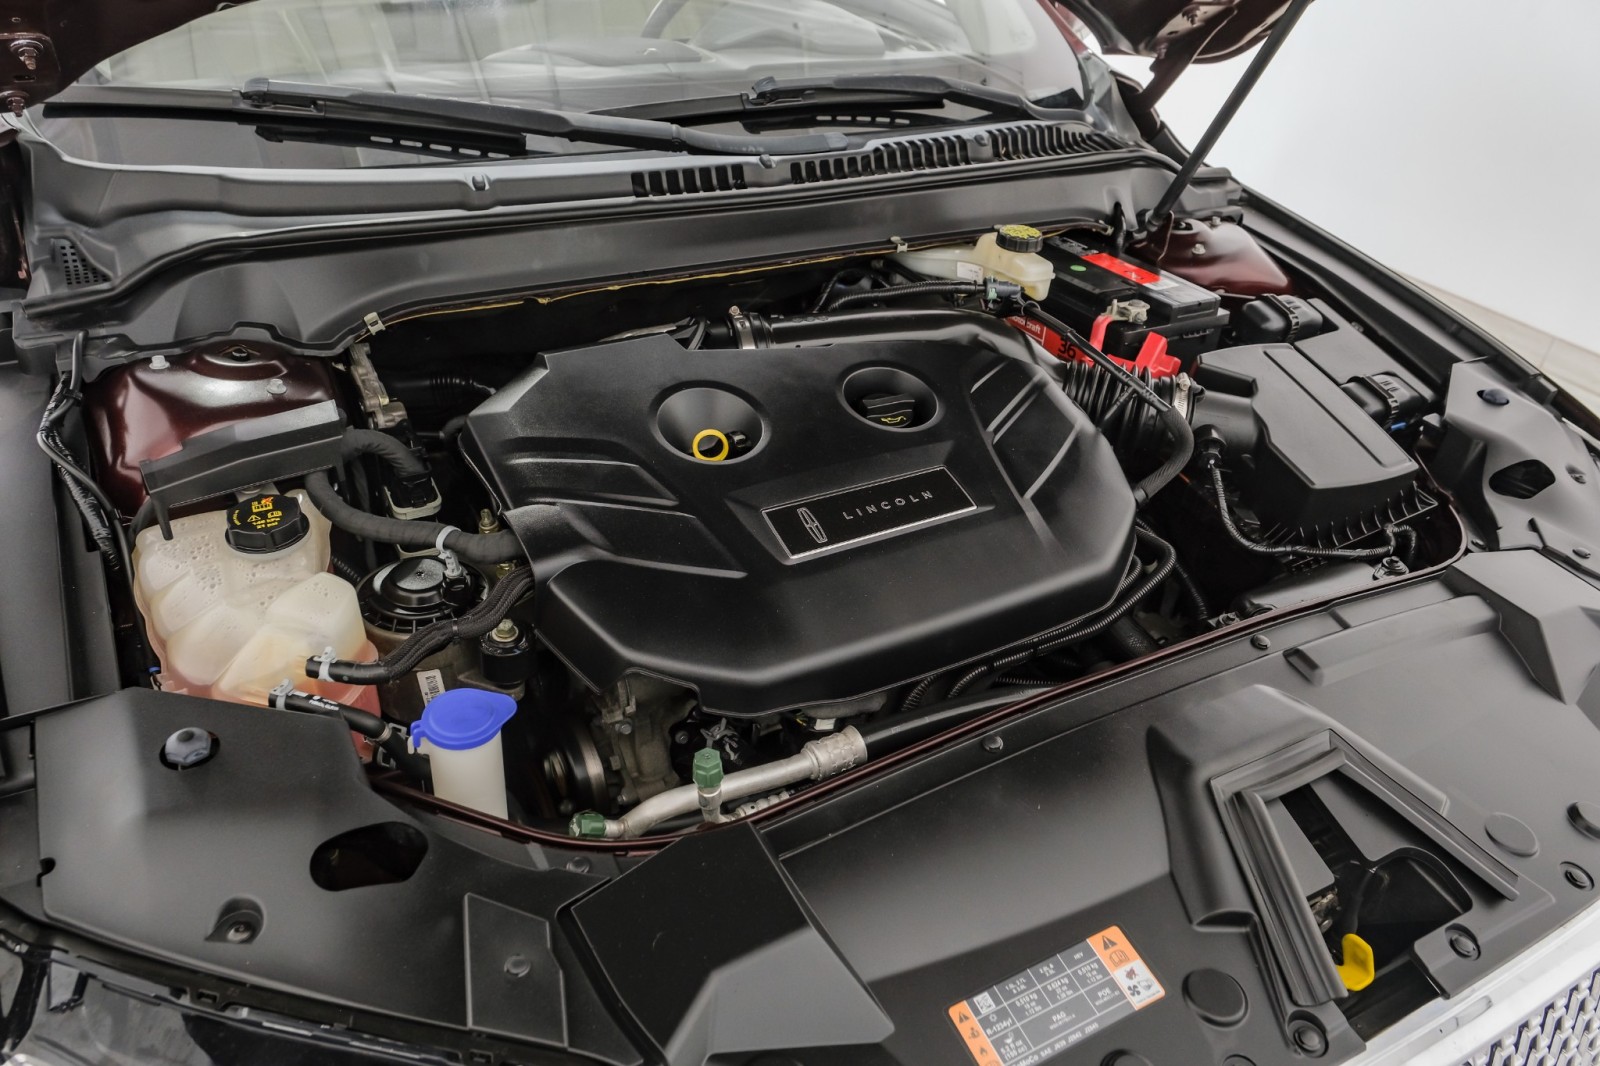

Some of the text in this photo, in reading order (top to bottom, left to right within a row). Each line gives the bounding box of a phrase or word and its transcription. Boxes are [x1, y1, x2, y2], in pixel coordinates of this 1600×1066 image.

[1059, 336, 1076, 359] 36
[842, 490, 933, 520] LINCOLN
[1097, 987, 1112, 998] POE
[1051, 1010, 1067, 1022] PAG
[986, 1017, 1013, 1036] R-1234yf
[1012, 1054, 1039, 1066] oMoCo
[1040, 1047, 1053, 1057] SAE
